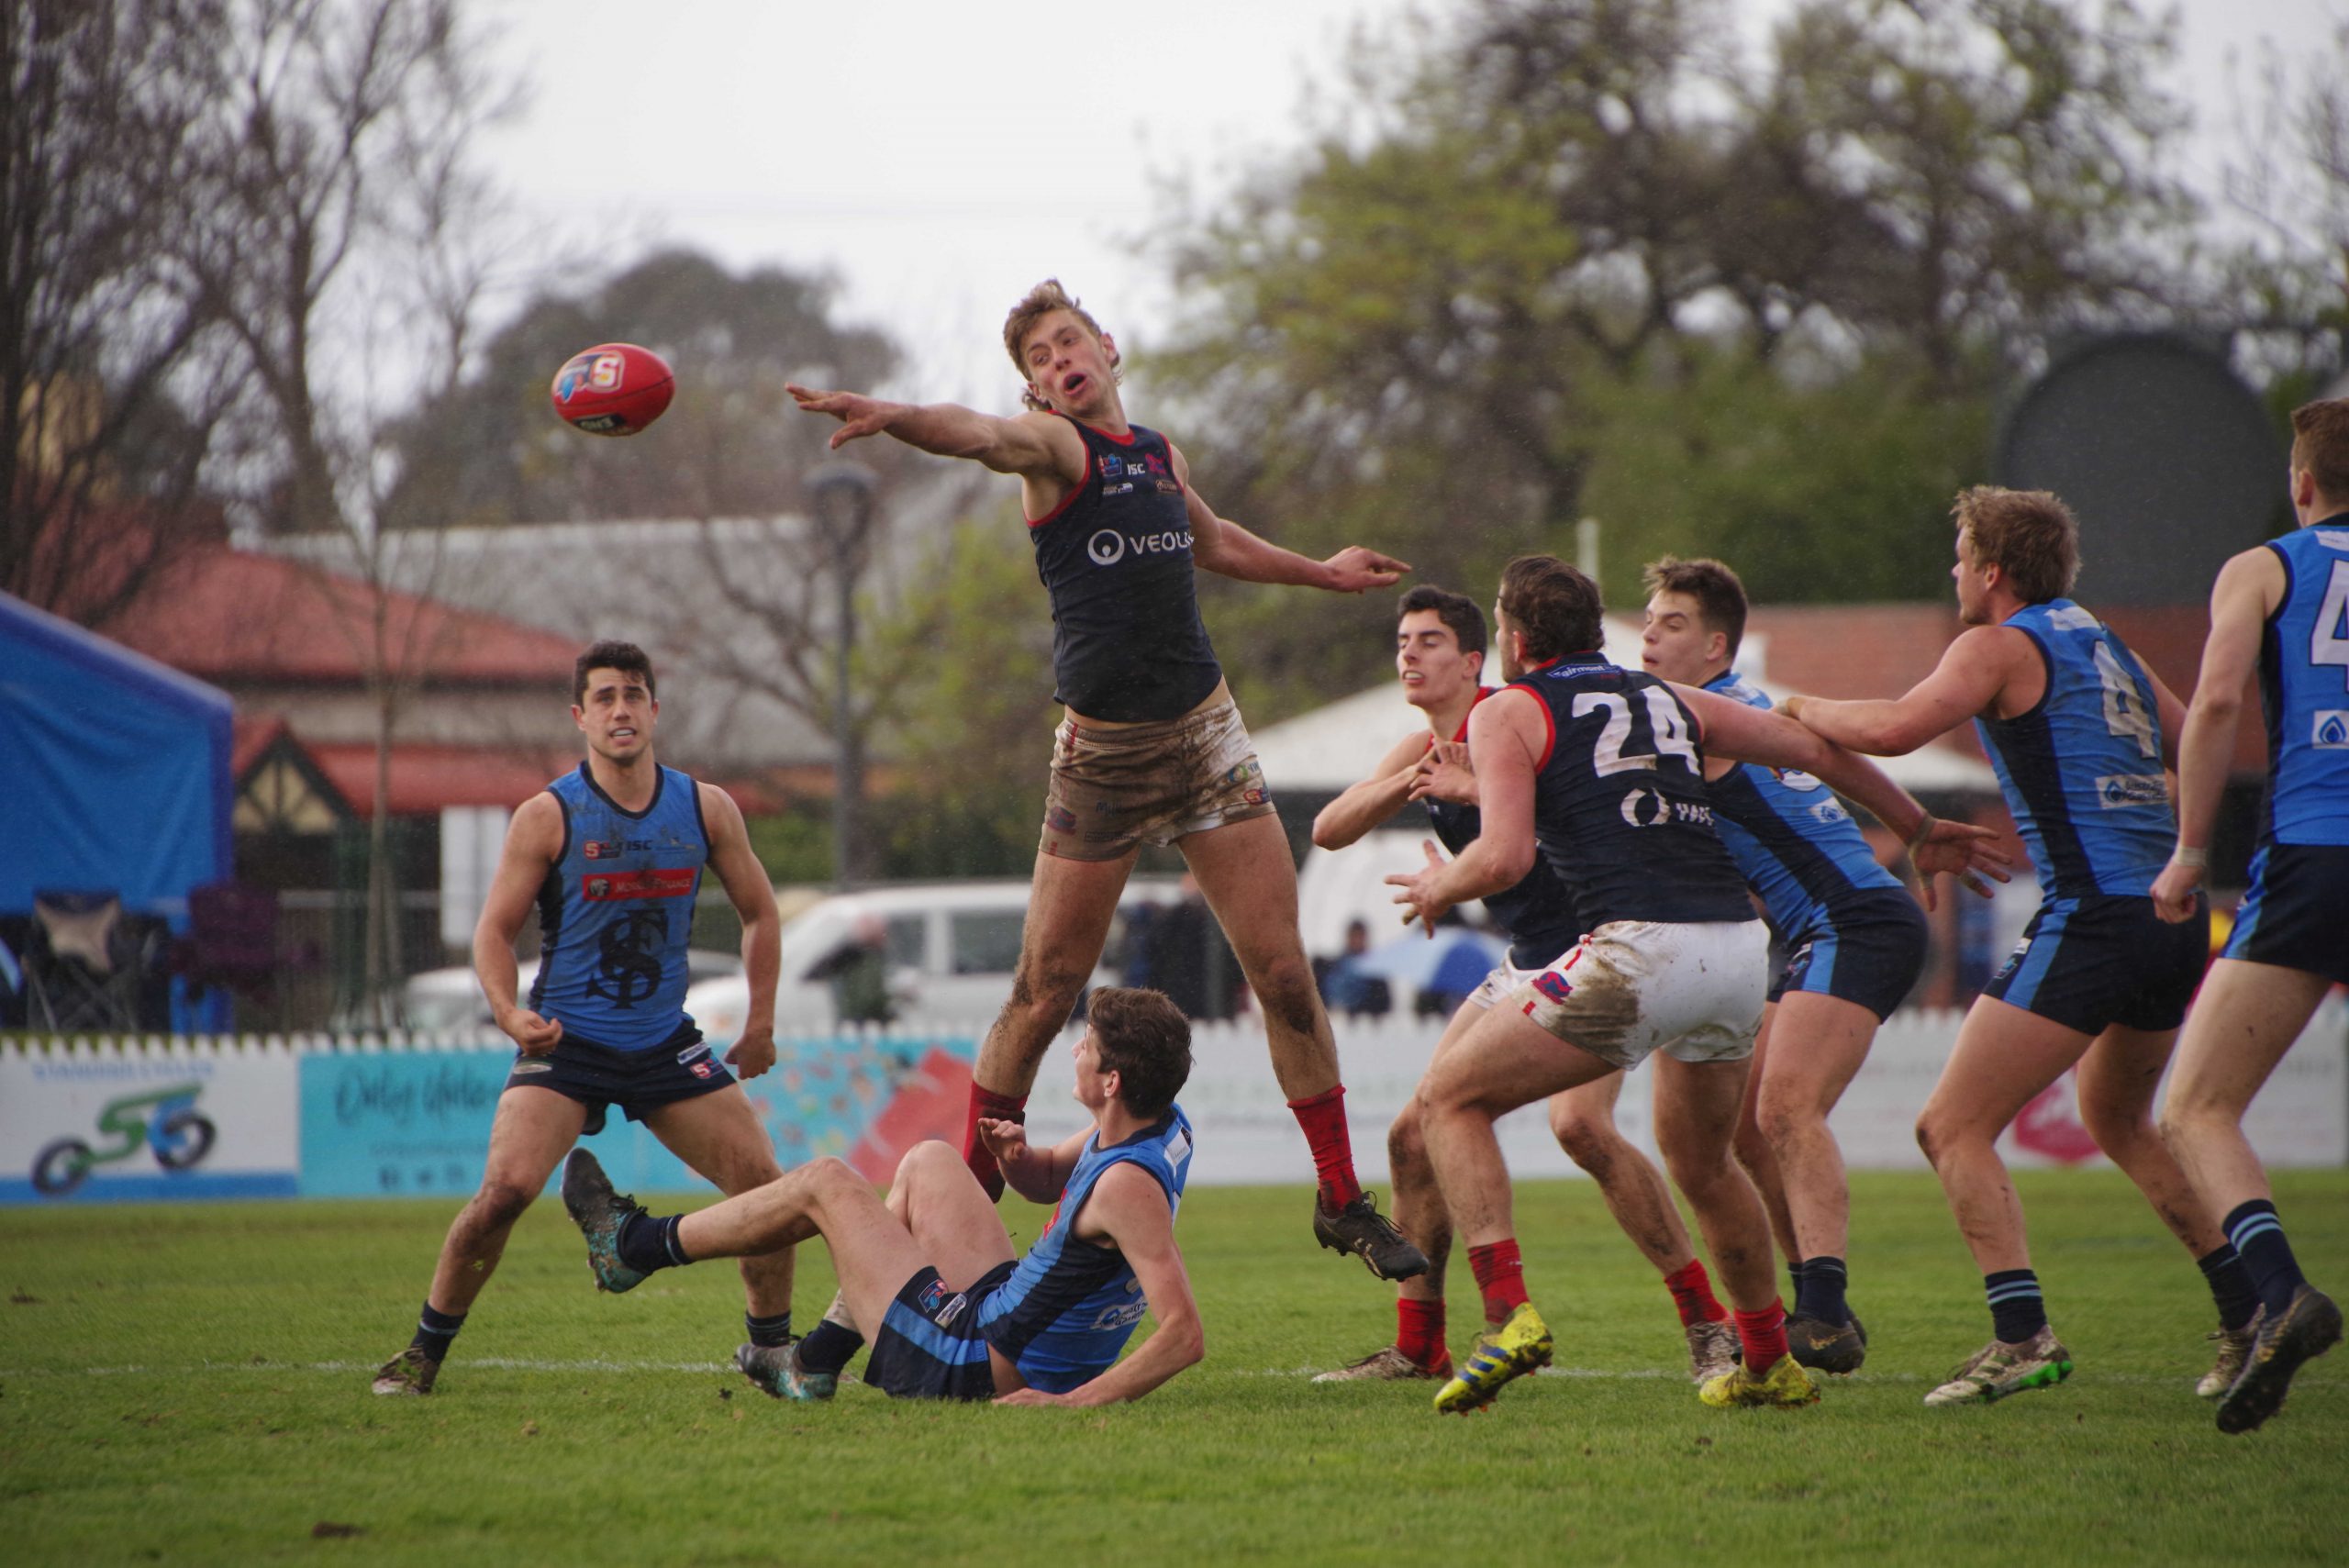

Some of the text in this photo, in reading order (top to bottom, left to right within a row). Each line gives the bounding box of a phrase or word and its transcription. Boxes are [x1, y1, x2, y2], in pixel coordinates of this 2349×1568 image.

[1127, 463, 1146, 476] ISC
[1571, 685, 1701, 778] 24
[2093, 640, 2156, 759] 4
